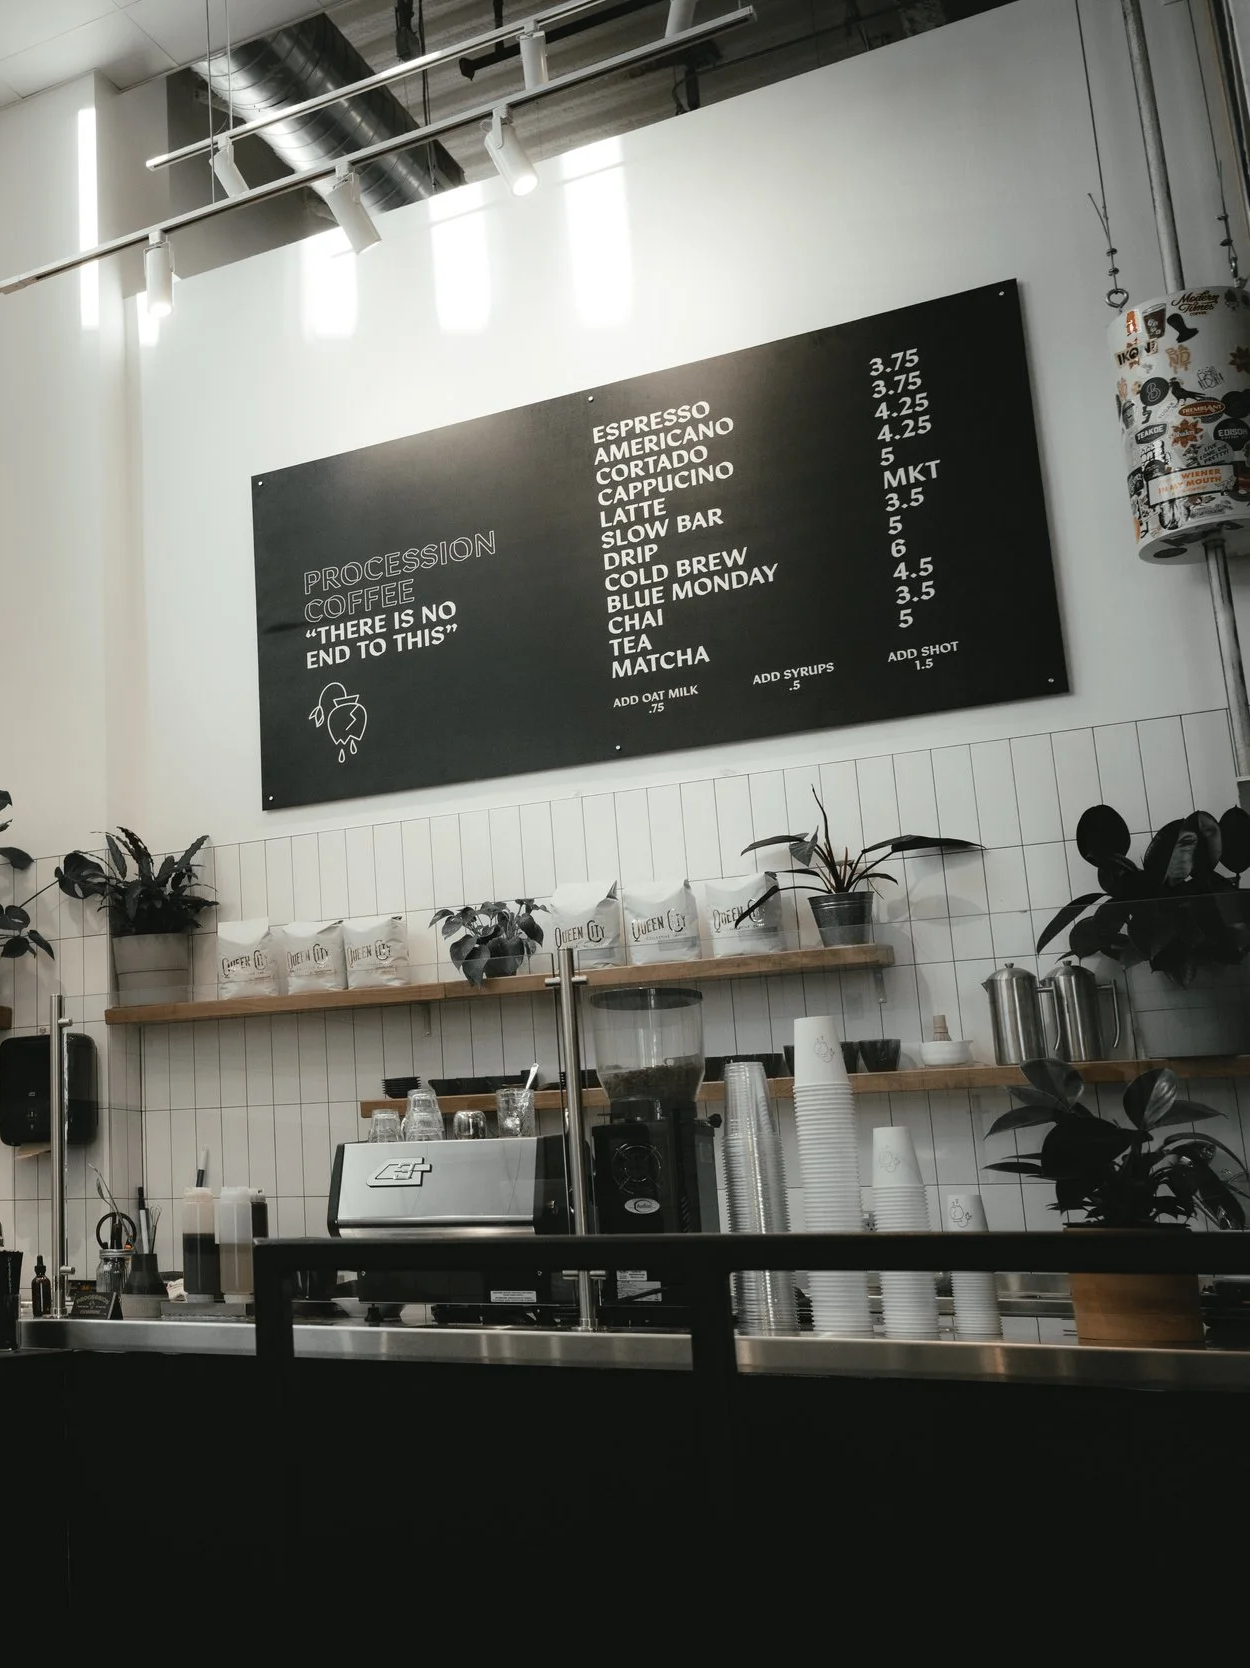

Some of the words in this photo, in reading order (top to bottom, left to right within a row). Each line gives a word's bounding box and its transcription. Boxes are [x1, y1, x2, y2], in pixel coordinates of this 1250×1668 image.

[869, 348, 919, 376] 3.75
[872, 371, 921, 398] 3.75
[875, 392, 929, 419] 4.25
[593, 401, 710, 444] ESPRESSO
[877, 415, 931, 442] 4.25
[594, 416, 734, 466] AMERICANO
[595, 445, 708, 485] CORTADO
[880, 447, 894, 466] 5
[597, 461, 734, 506] CAPPUCINO
[884, 460, 940, 489] MKT
[1182, 468, 1222, 479] WIENER
[1186, 476, 1222, 487] MOUTH
[600, 497, 667, 528] LATTE
[885, 487, 924, 511] 3.5
[601, 518, 669, 549] SLOW
[676, 508, 724, 533] BAR
[888, 515, 902, 535] 5
[603, 543, 658, 571] DRIP
[891, 539, 906, 557] 6
[304, 530, 496, 595] PROCESSION
[605, 564, 669, 591] COLD
[676, 546, 747, 578] BREW
[893, 557, 933, 580] 4.5
[304, 578, 415, 623] COFFEE
[607, 586, 665, 613] BLUE
[672, 563, 778, 601] MONDAY
[896, 581, 935, 604] 3.5
[394, 609, 414, 630] IS
[422, 601, 456, 624] NO
[608, 608, 663, 634] CHAI
[899, 609, 913, 628] 5
[307, 645, 350, 669] END
[356, 638, 387, 659] TO
[609, 633, 653, 656] TEA
[888, 649, 917, 662] ADD
[921, 641, 958, 656] SHOT
[612, 645, 710, 679] MATCHA
[753, 672, 780, 685] ADD
[783, 662, 834, 679] SYRUPS
[915, 658, 933, 670] 1.5
[613, 695, 639, 708] ADD
[642, 690, 665, 703] OAT
[668, 685, 698, 699] MILK
[789, 680, 800, 691] .5
[649, 702, 664, 713] .75
